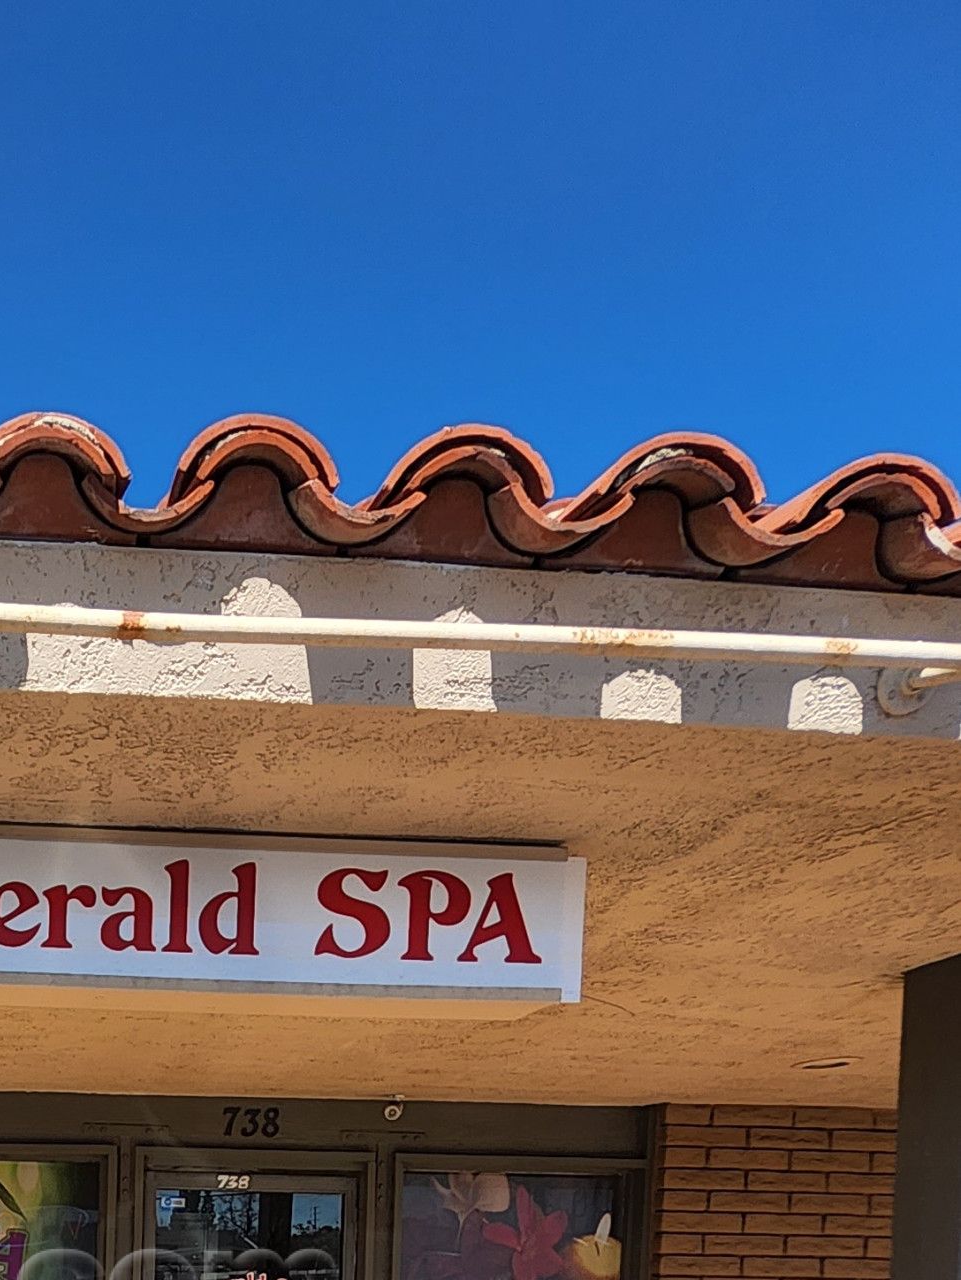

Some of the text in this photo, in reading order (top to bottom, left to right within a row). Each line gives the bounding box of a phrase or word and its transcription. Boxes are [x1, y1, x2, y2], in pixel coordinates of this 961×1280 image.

[314, 867, 542, 965] SPA
[222, 1106, 281, 1138] 738
[216, 1174, 251, 1189] 738
